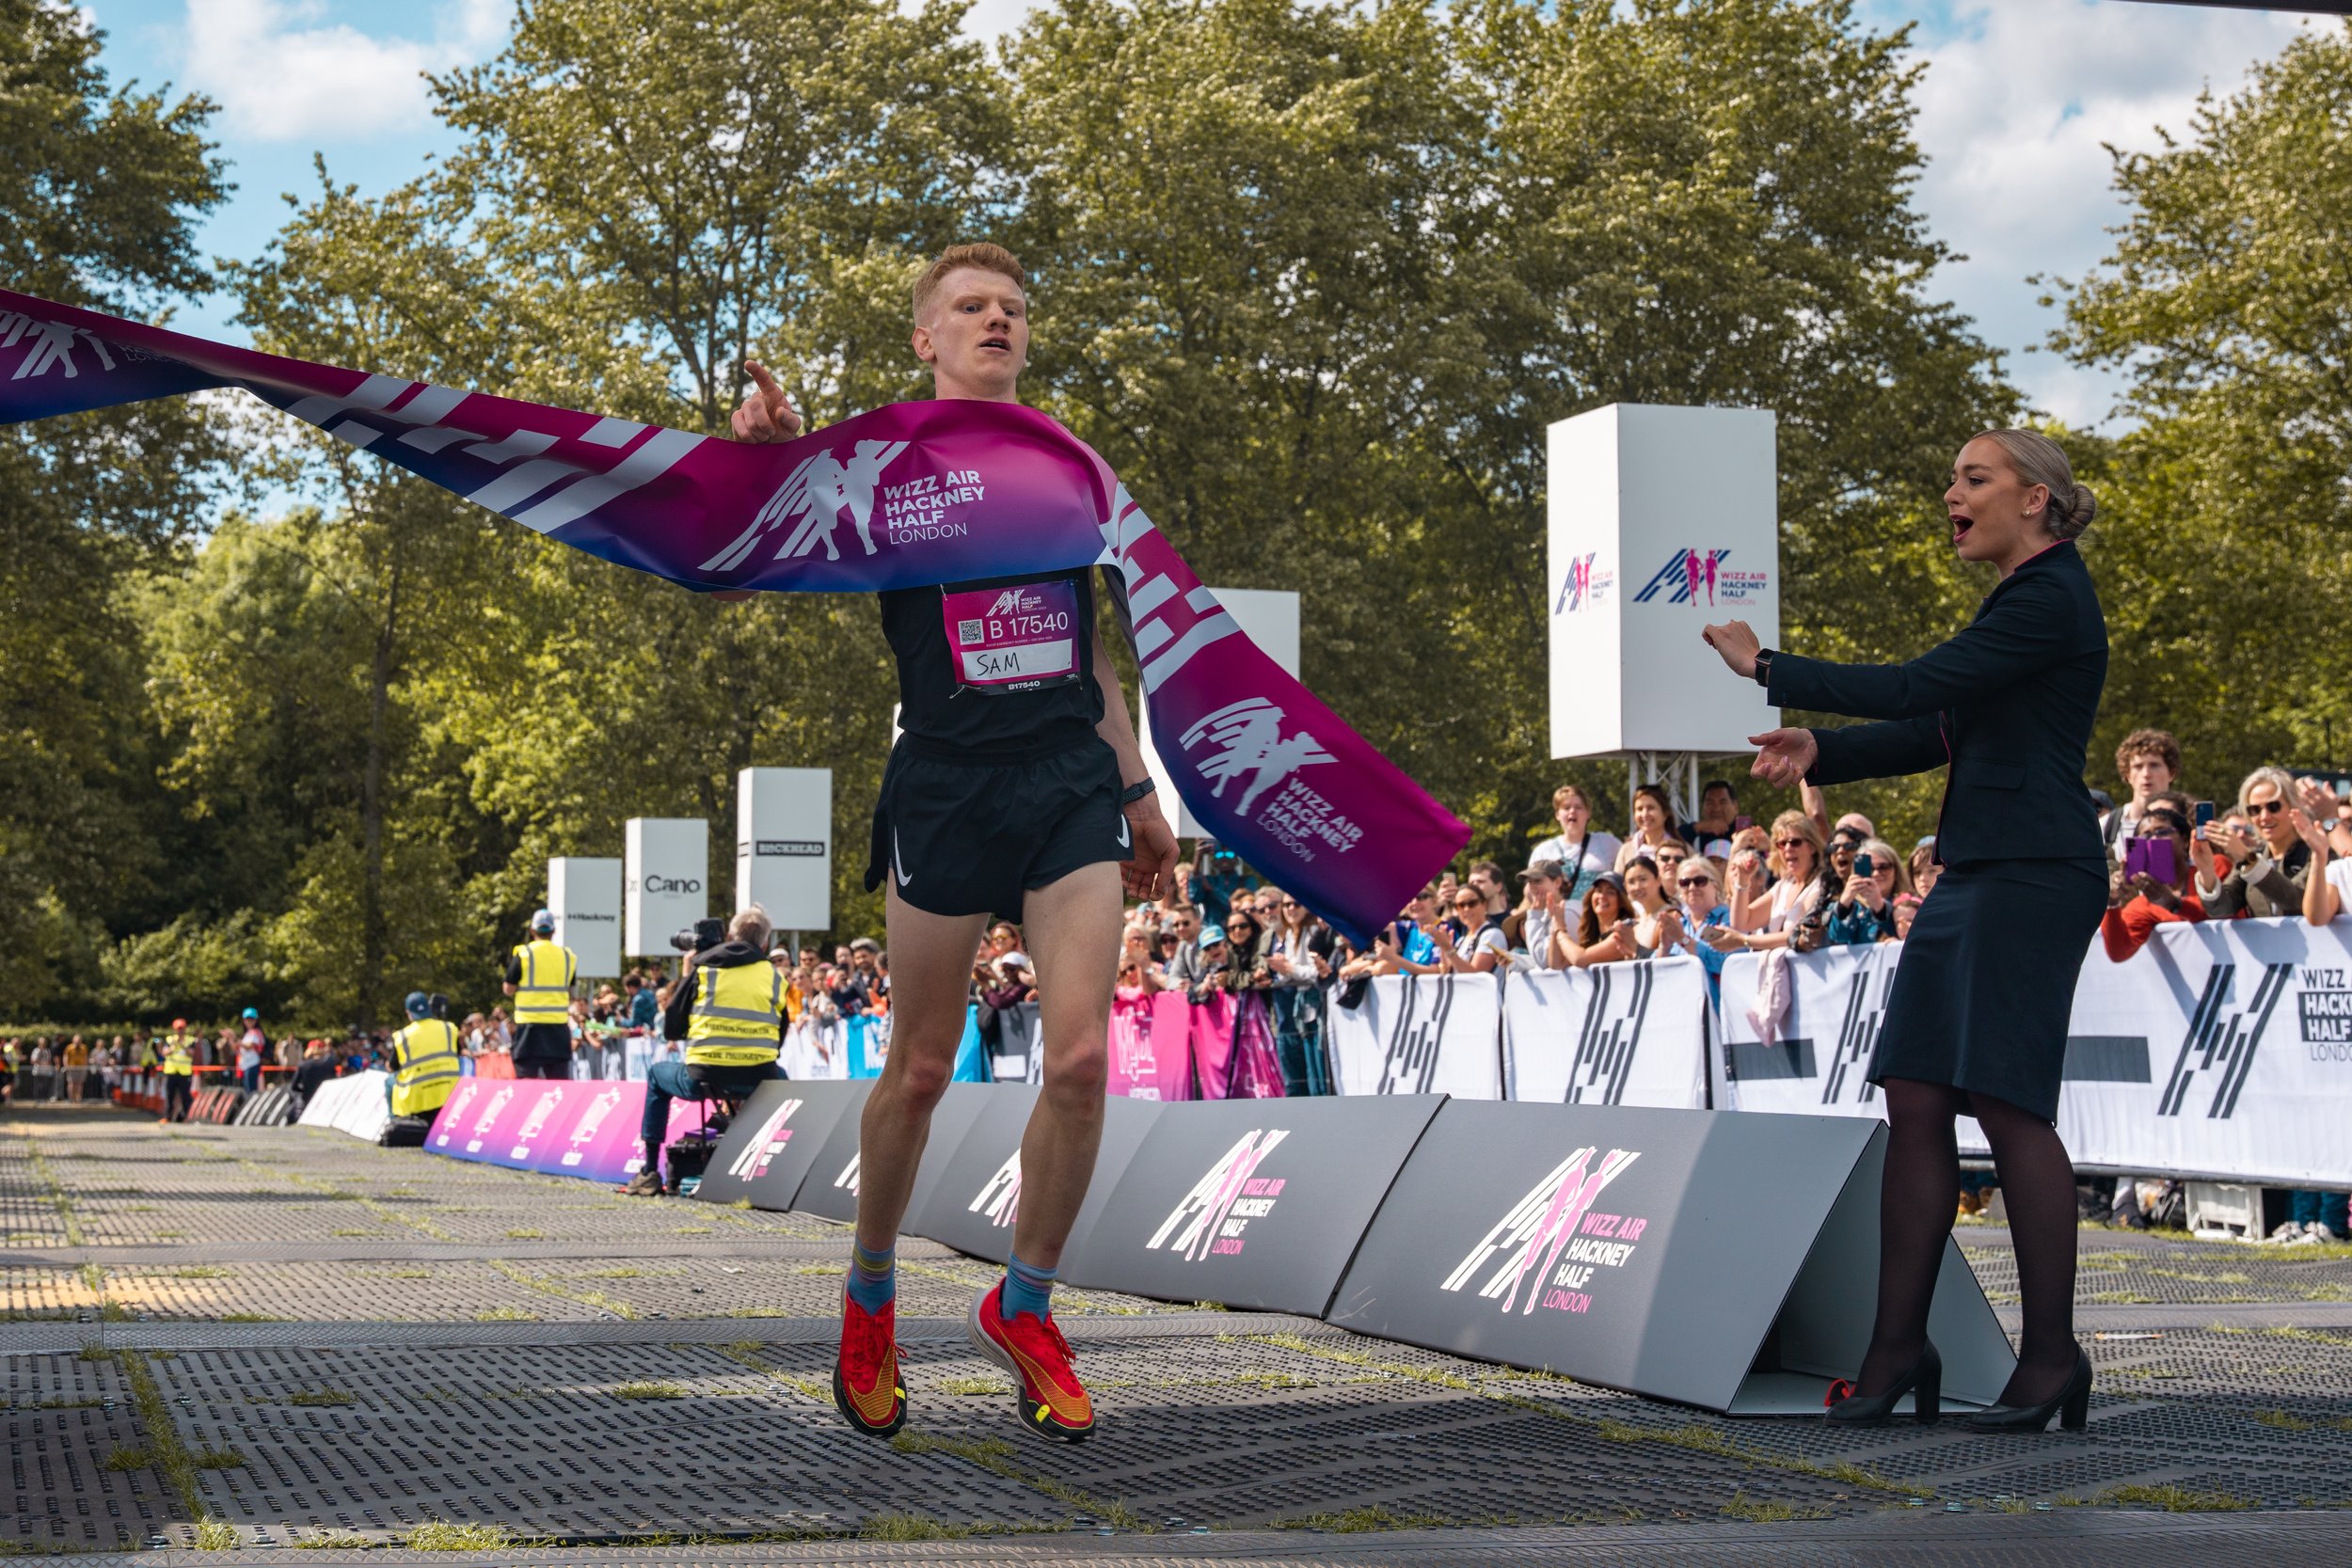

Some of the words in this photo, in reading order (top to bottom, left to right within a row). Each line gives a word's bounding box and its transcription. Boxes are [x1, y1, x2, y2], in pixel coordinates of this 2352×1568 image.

[884, 475, 939, 499] WIZZ
[946, 470, 981, 487] AIR
[885, 486, 985, 516] HACKNEY
[888, 510, 945, 529] HALF
[890, 523, 967, 545] LONDON
[1721, 572, 1746, 580] WIZZ
[1749, 572, 1766, 580] AIR
[1721, 581, 1767, 590] HACKNEY
[990, 620, 1003, 640] B
[1009, 611, 1068, 636] 17540
[977, 652, 1020, 676] SAM
[1009, 680, 1040, 690] B17540
[1265, 801, 1313, 838] HALF
[1276, 790, 1356, 853] HACKNEY
[1288, 778, 1334, 817] WIZZ
[1328, 816, 1364, 842] AIR
[1256, 813, 1316, 862] LONDON
[645, 875, 701, 894] Cano
[2302, 969, 2344, 989] WIZZ
[2305, 993, 2352, 1016] HACK
[2307, 1019, 2351, 1041] HALF
[1242, 1179, 1270, 1196] WIZZ
[1263, 1179, 1286, 1196] AIR
[1230, 1198, 1277, 1217] HACKNEY
[1219, 1218, 1248, 1237] HALF
[1581, 1212, 1621, 1237] WIZZ
[1614, 1217, 1646, 1241] AIR
[1212, 1239, 1245, 1255] LONDON
[1565, 1238, 1635, 1267] HACKNEY
[1552, 1263, 1595, 1289] HALF
[1543, 1289, 1592, 1313] LONDON
